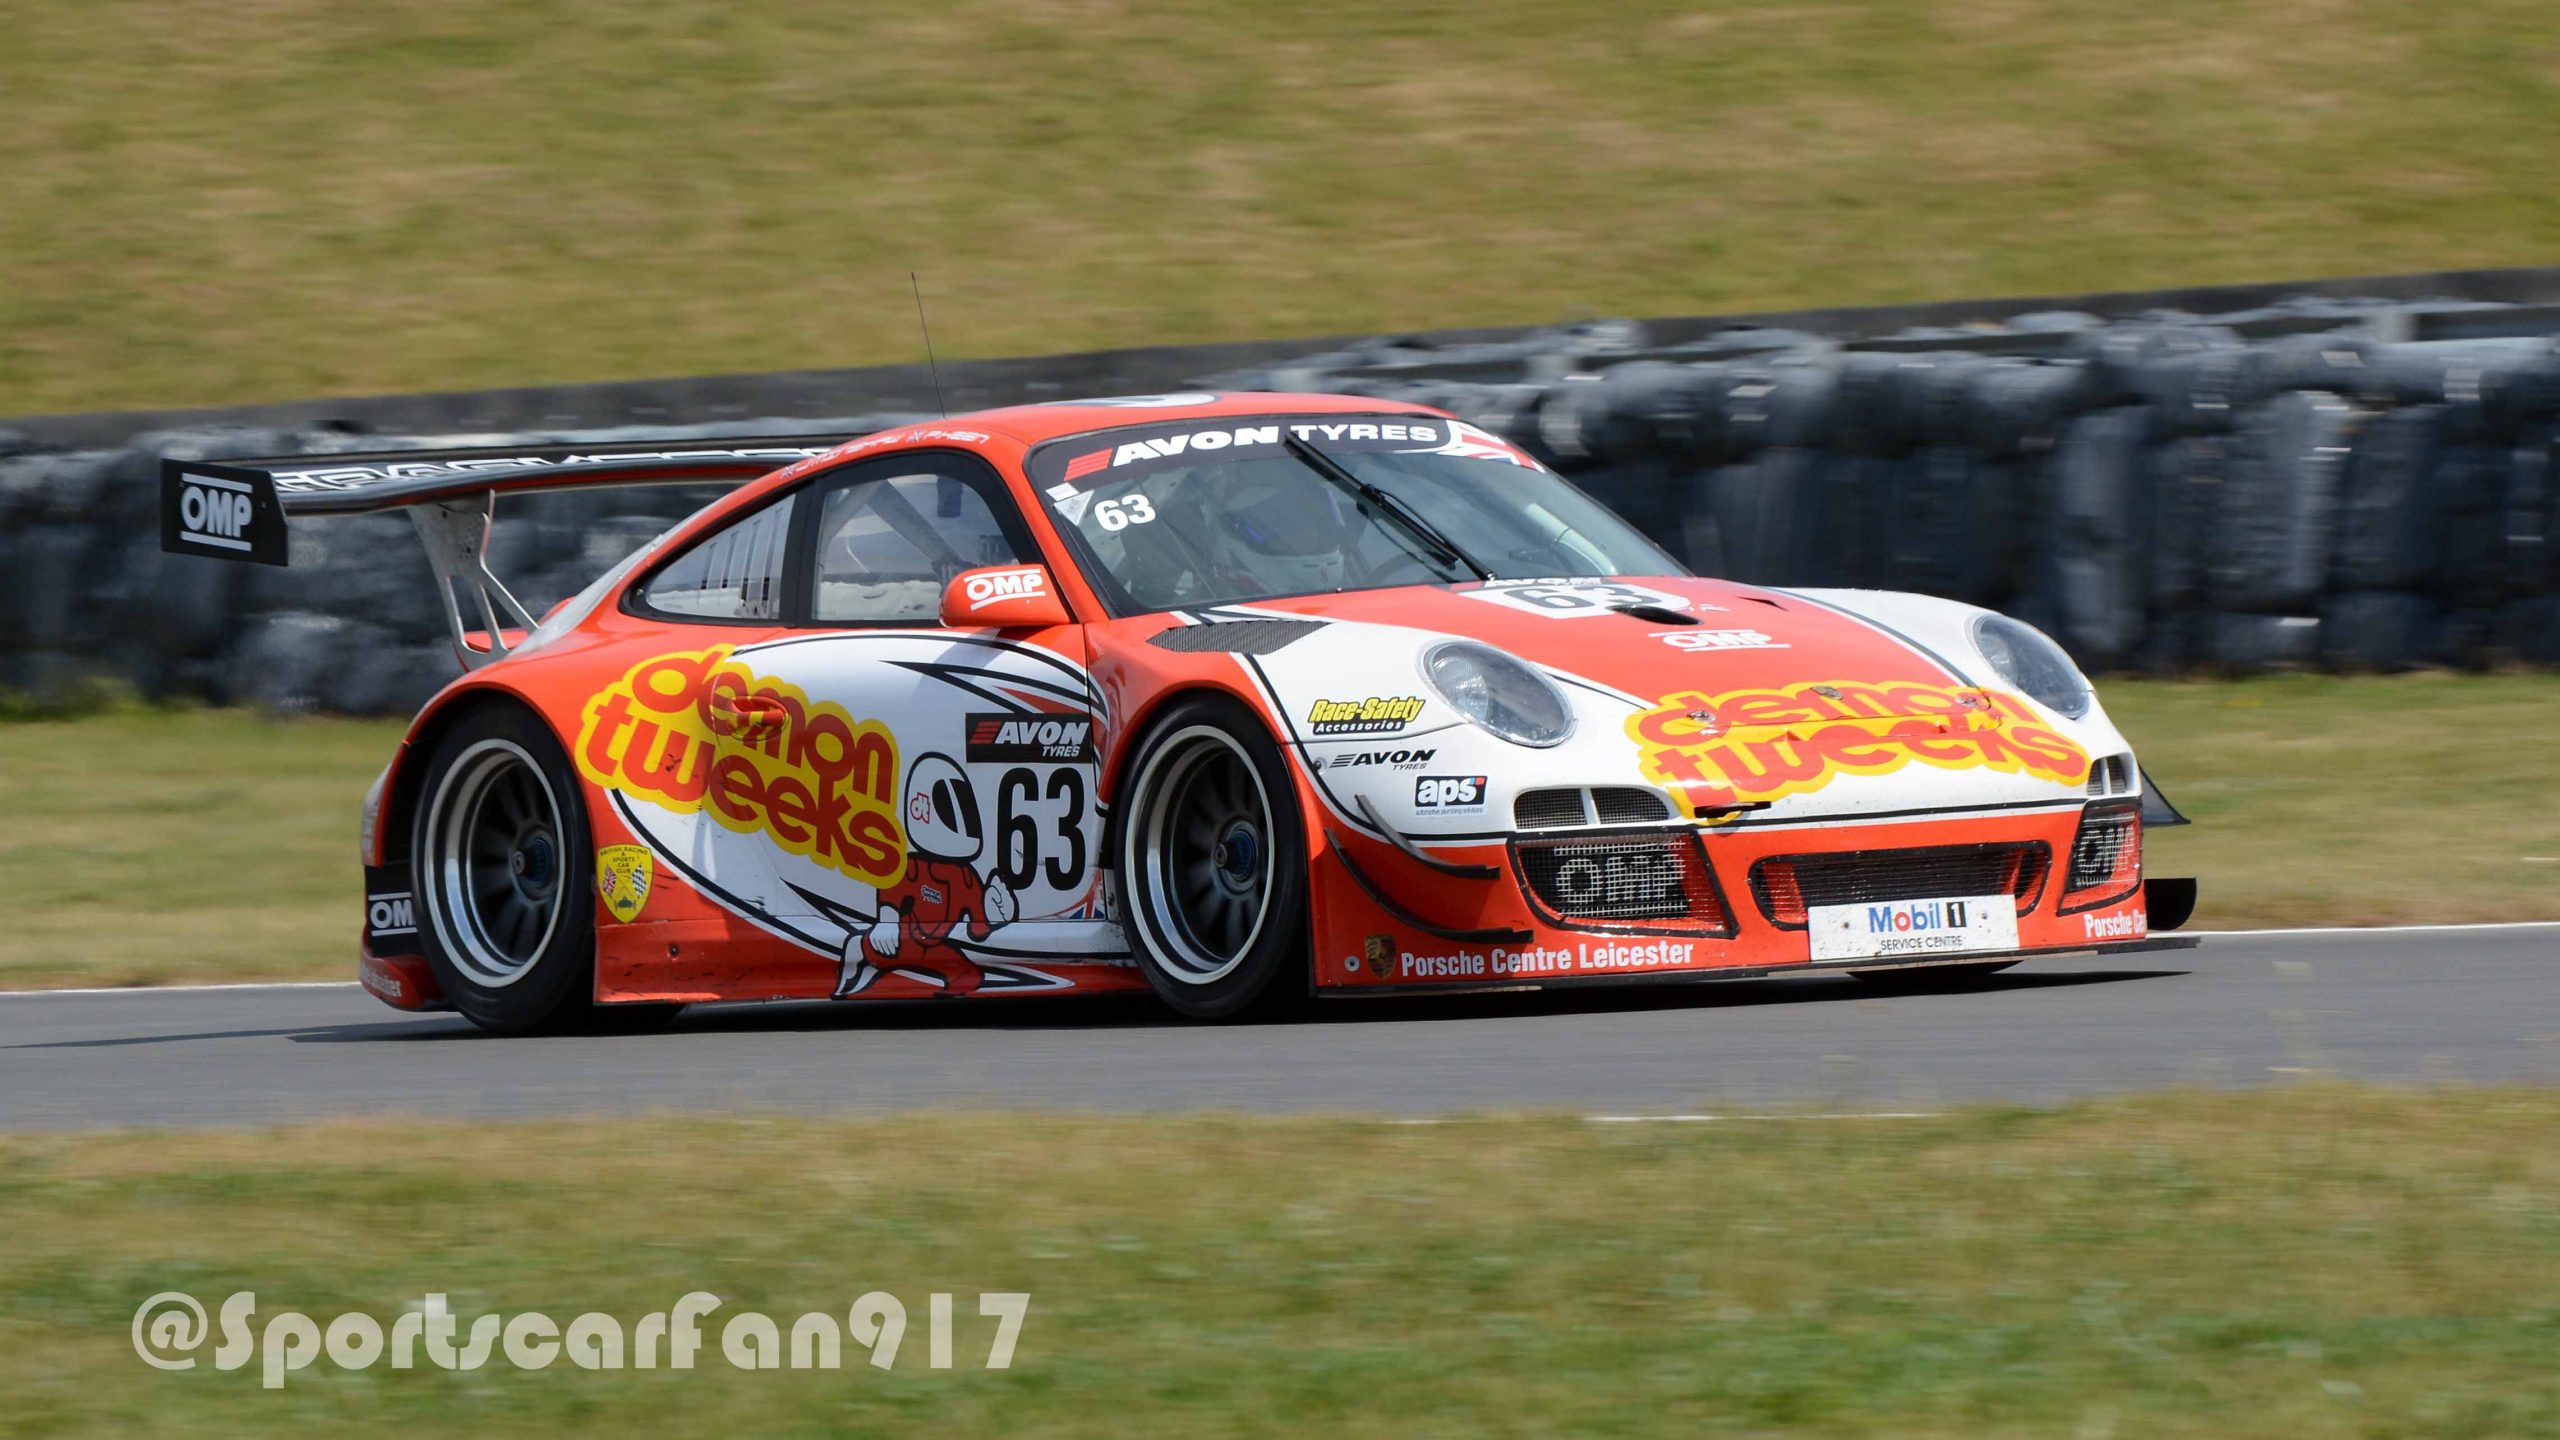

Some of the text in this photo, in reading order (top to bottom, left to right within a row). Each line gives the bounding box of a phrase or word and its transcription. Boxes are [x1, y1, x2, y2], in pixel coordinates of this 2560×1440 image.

[1112, 424, 1437, 467] AVON TYRES
[181, 486, 253, 538] OMP
[1094, 494, 1156, 531] 63
[966, 573, 1043, 601] OMP
[1503, 585, 1664, 609] 63
[1663, 631, 1773, 648] OMP
[1309, 697, 1425, 722] Race-Safety
[1638, 686, 2040, 747] demon
[632, 651, 894, 804] demon
[995, 721, 1091, 745] AVON
[1315, 720, 1402, 733] Accessories
[1042, 745, 1081, 757] TYRES
[1353, 750, 1437, 766] AVON
[1655, 712, 2087, 808] tweeks
[1392, 763, 1427, 771] TYRES
[586, 692, 901, 877] tweeks
[1417, 777, 1477, 807] aps
[997, 767, 1087, 891] 63
[1556, 854, 1686, 904] OMP
[370, 899, 416, 930] OM
[1867, 902, 1965, 934] Mobil 1
[2083, 910, 2130, 938] Porsche
[1880, 935, 1963, 951] SERVICE CENTRE
[1402, 940, 1694, 977] Porsche Centre Leicester
